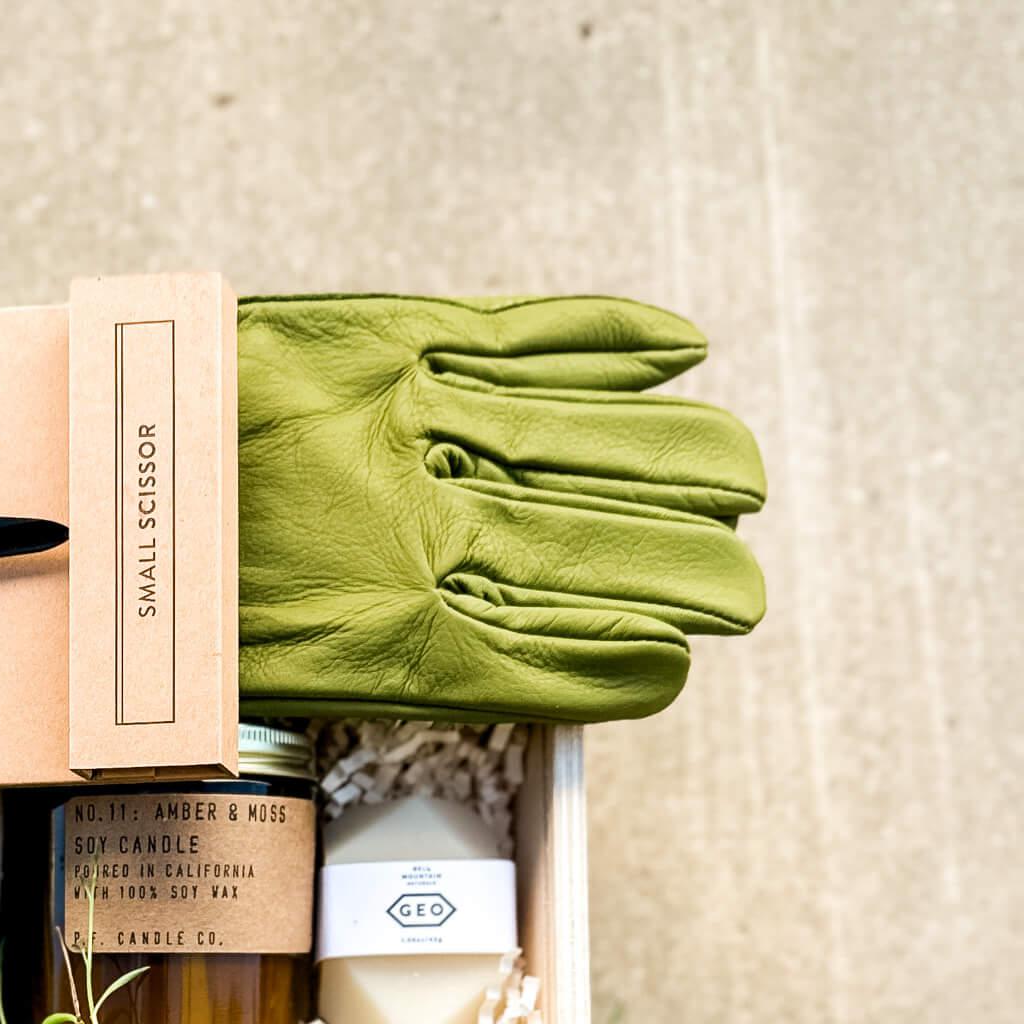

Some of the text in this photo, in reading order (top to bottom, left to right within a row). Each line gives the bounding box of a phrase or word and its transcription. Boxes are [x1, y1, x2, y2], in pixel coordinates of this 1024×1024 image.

[138, 423, 156, 617] SMALL SCISSOR
[75, 802, 287, 823] NO.11: AMBER & MOSS
[75, 835, 199, 854] SOY CANDLE
[139, 863, 155, 878] IN
[165, 863, 256, 878] CALIFORNIA
[119, 885, 158, 899] 100%
[170, 885, 199, 898] SOY
[211, 885, 239, 898] WAX
[399, 903, 444, 917] GEO
[117, 931, 185, 946] CANDLE
[197, 931, 224, 946] CO.
